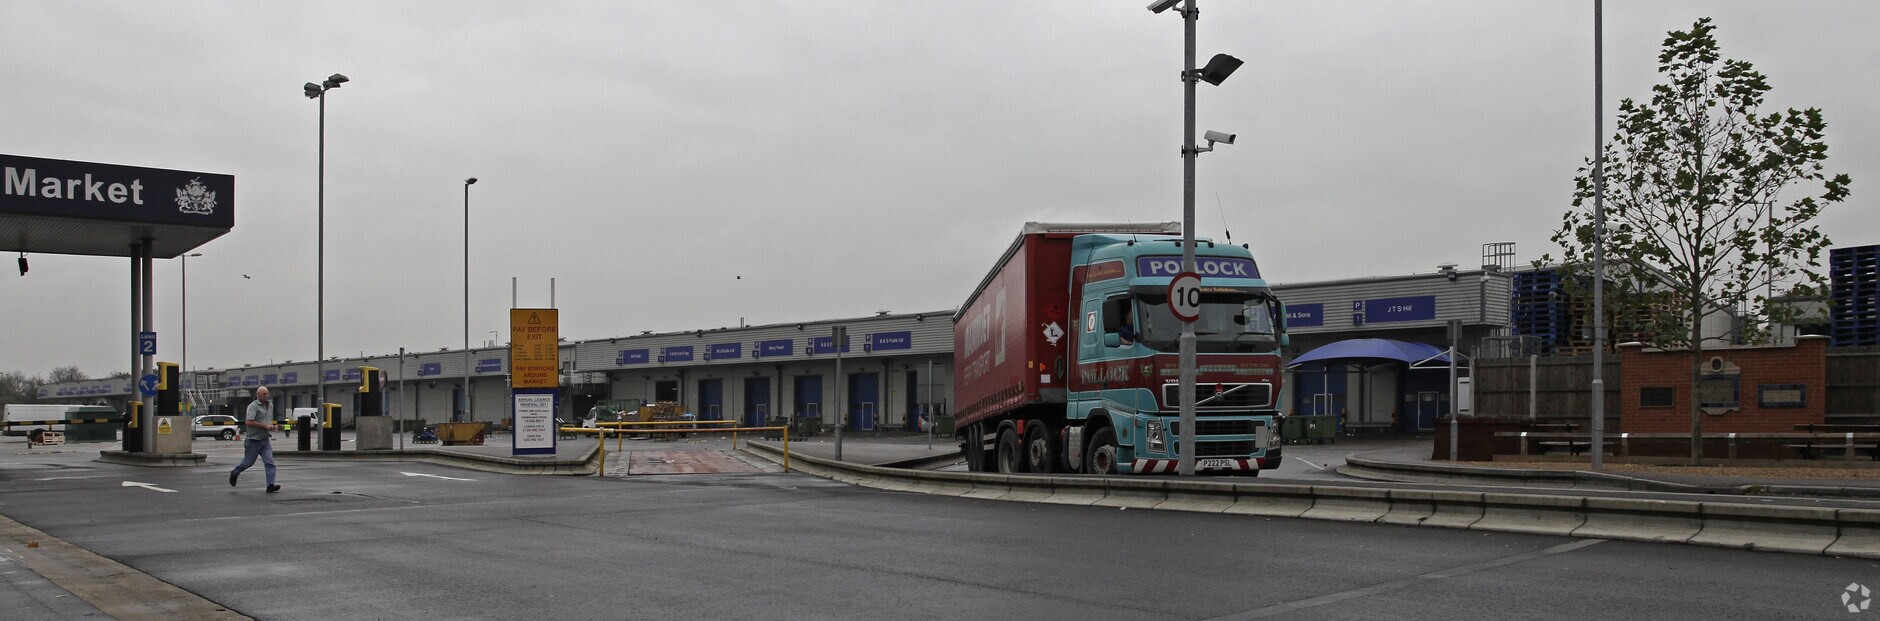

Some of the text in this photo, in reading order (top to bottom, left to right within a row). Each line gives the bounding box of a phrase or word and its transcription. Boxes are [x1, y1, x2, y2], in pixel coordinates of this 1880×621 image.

[4, 166, 144, 205] Market
[1177, 286, 1200, 308] 10
[1297, 311, 1311, 319] Sons
[143, 340, 153, 352] 2
[1081, 365, 1130, 385] POLLOCK
